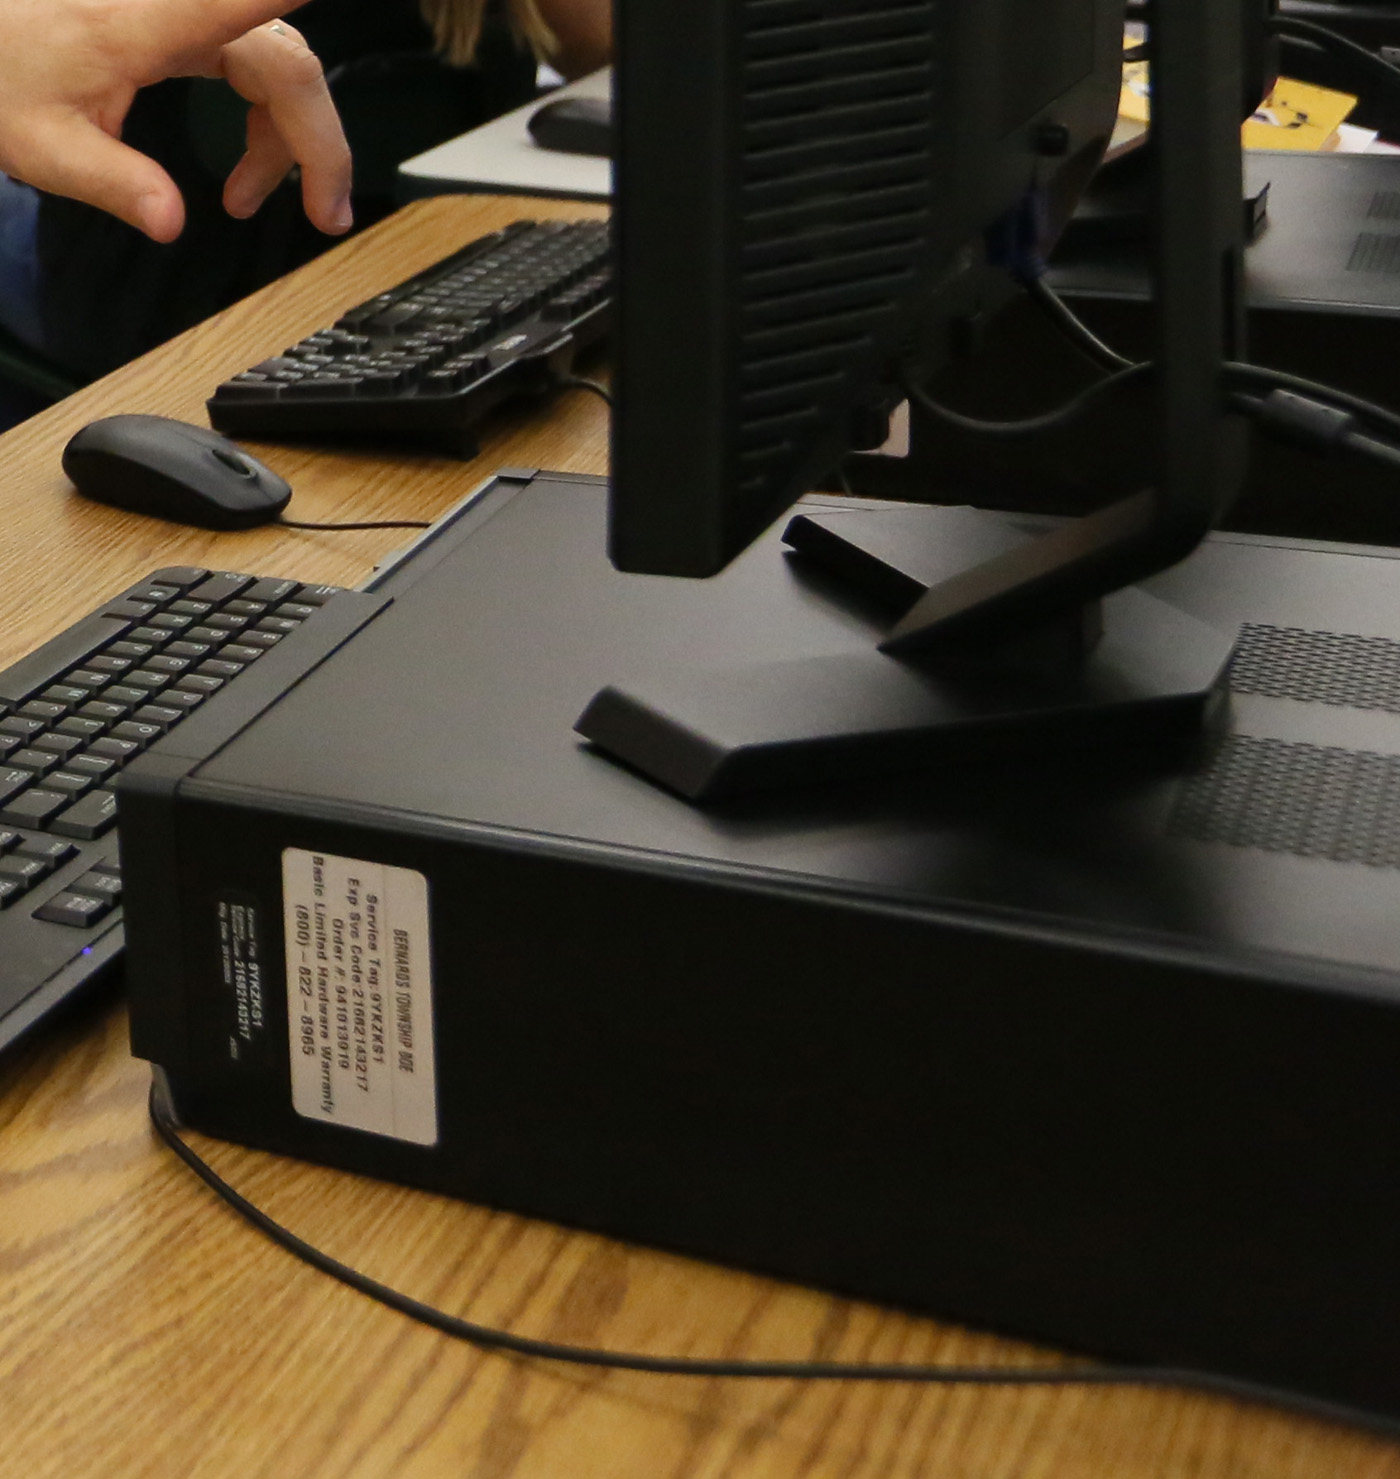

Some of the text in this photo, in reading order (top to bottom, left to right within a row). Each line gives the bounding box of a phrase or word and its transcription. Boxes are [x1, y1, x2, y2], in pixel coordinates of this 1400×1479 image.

[346, 878, 360, 906] Exp
[332, 918, 346, 962] Order
[349, 912, 361, 939] Svc
[366, 894, 379, 951] Service
[312, 856, 335, 1115] Basic Limited Hardware Warranty
[396, 992, 413, 1048] TOWNSHIP
